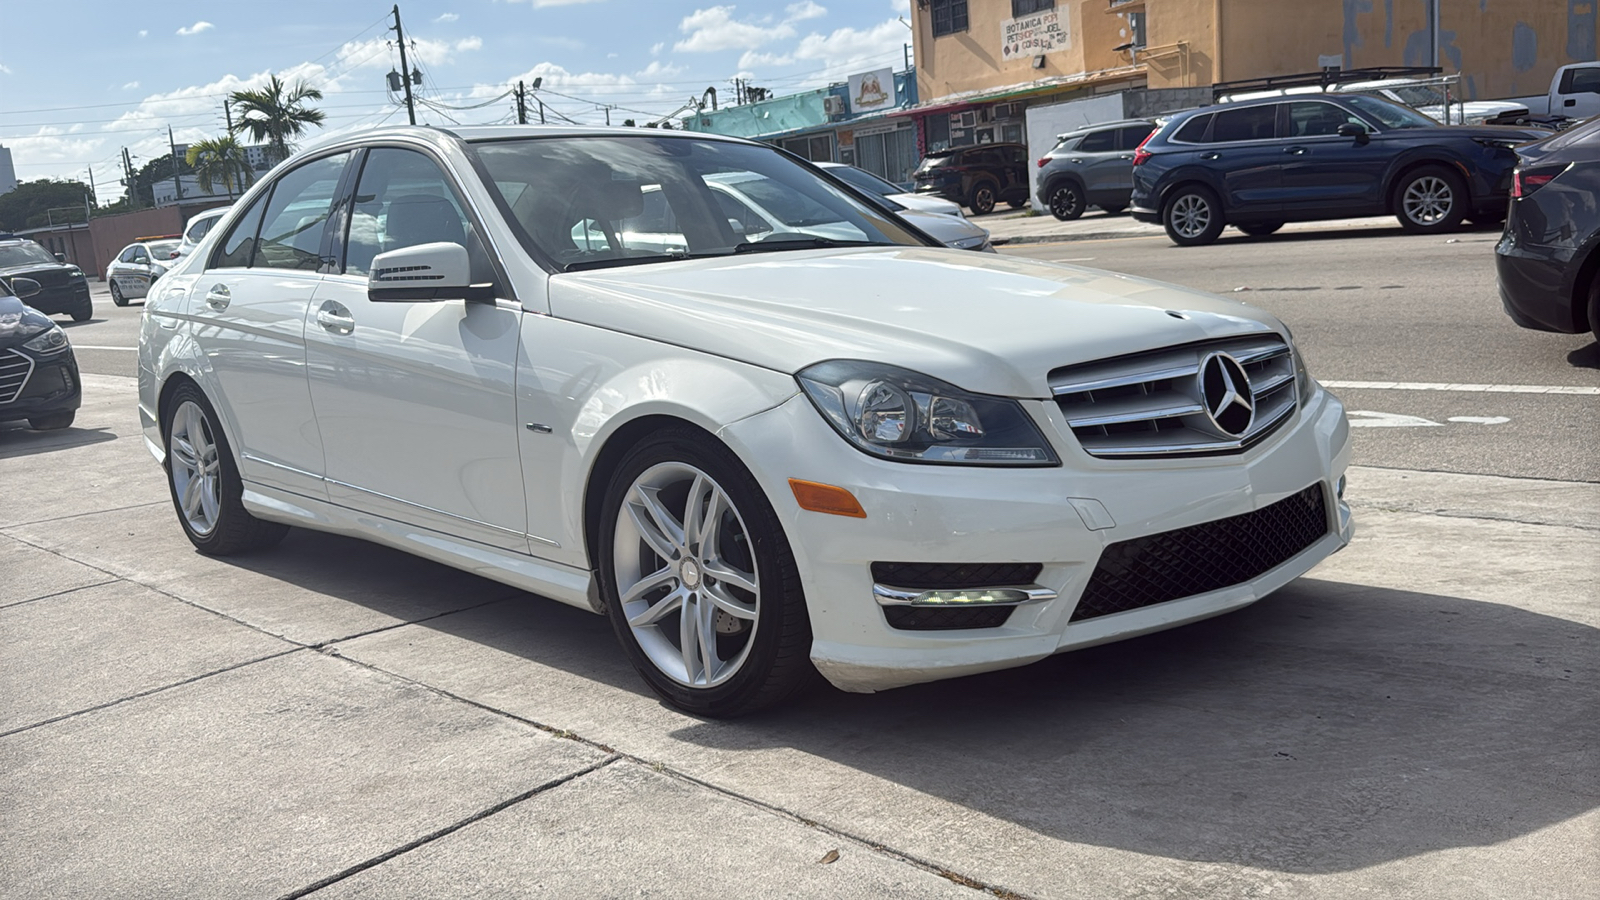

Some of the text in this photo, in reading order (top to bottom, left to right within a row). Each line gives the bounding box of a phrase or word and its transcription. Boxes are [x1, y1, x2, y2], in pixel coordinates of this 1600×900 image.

[1006, 17, 1041, 34] BOTANICA
[1045, 23, 1061, 33] JOEL
[1022, 39, 1053, 50] CONSLTA
